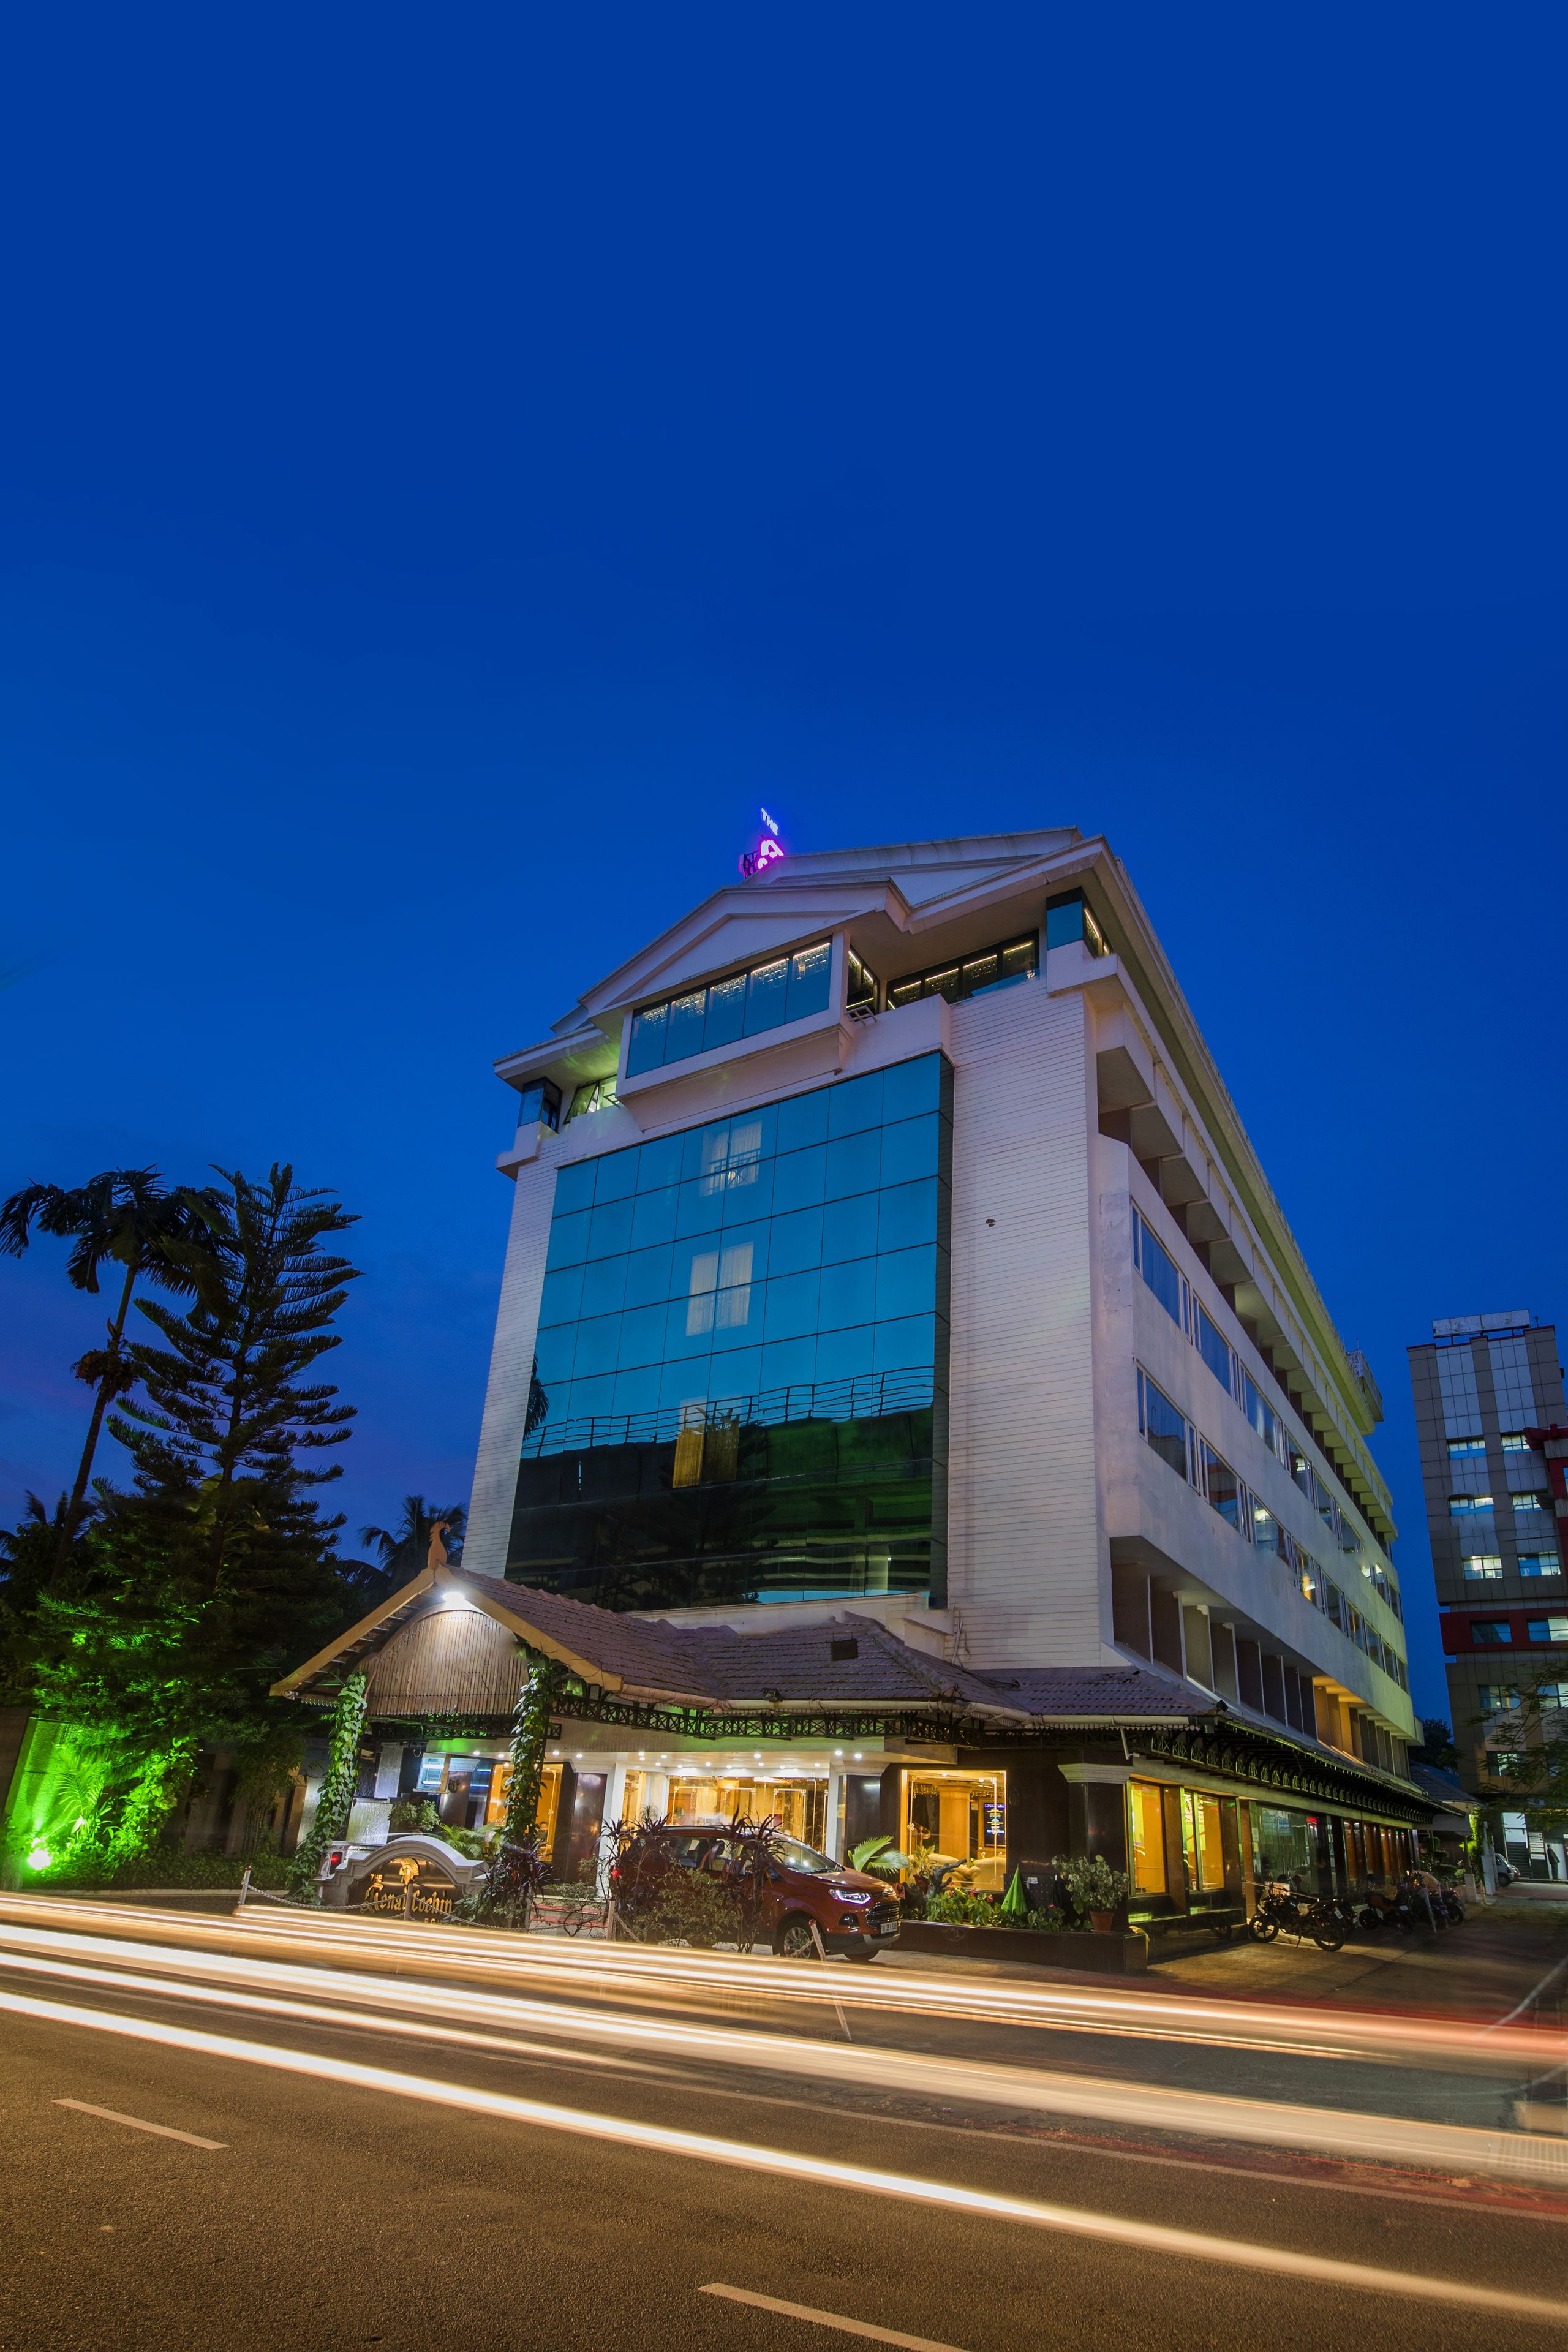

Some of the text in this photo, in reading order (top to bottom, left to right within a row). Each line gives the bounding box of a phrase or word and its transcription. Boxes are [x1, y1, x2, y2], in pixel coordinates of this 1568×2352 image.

[761, 808, 778, 836] THE
[371, 1874, 383, 1882] THE
[412, 1890, 452, 1914] Cochin
